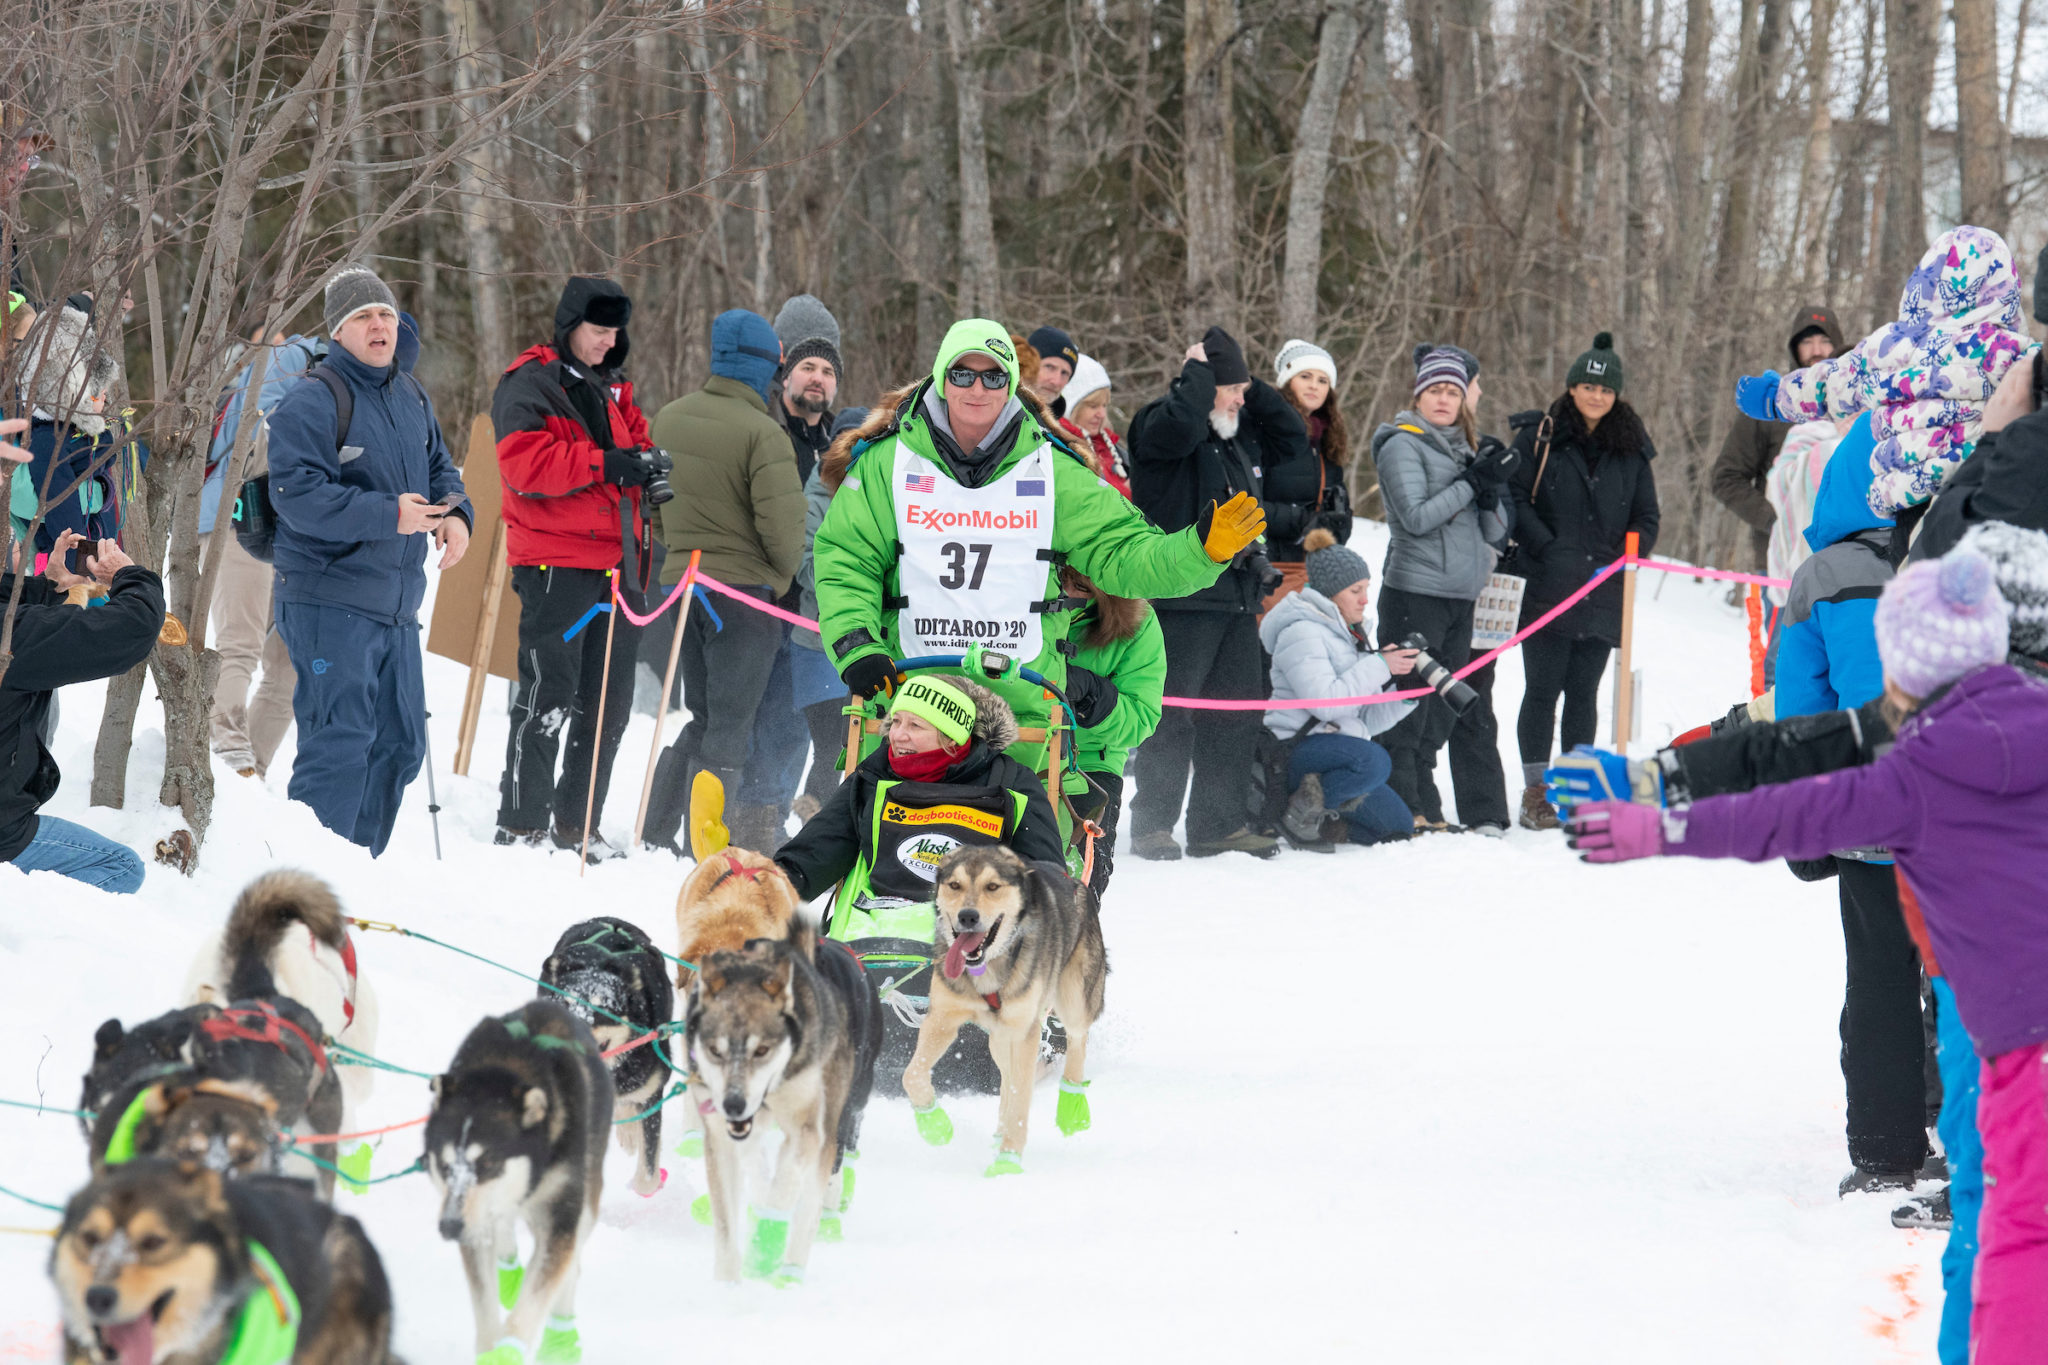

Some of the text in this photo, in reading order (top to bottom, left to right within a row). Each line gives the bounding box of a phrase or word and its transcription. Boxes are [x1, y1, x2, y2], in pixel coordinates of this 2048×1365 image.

[906, 504, 1038, 532] ExxonMobil
[939, 541, 993, 590] 37
[914, 618, 1001, 638] IDITAROD
[923, 639, 1018, 649] www.iditod.com
[908, 810, 999, 833] dogbooties.com
[906, 839, 950, 855] Alask
